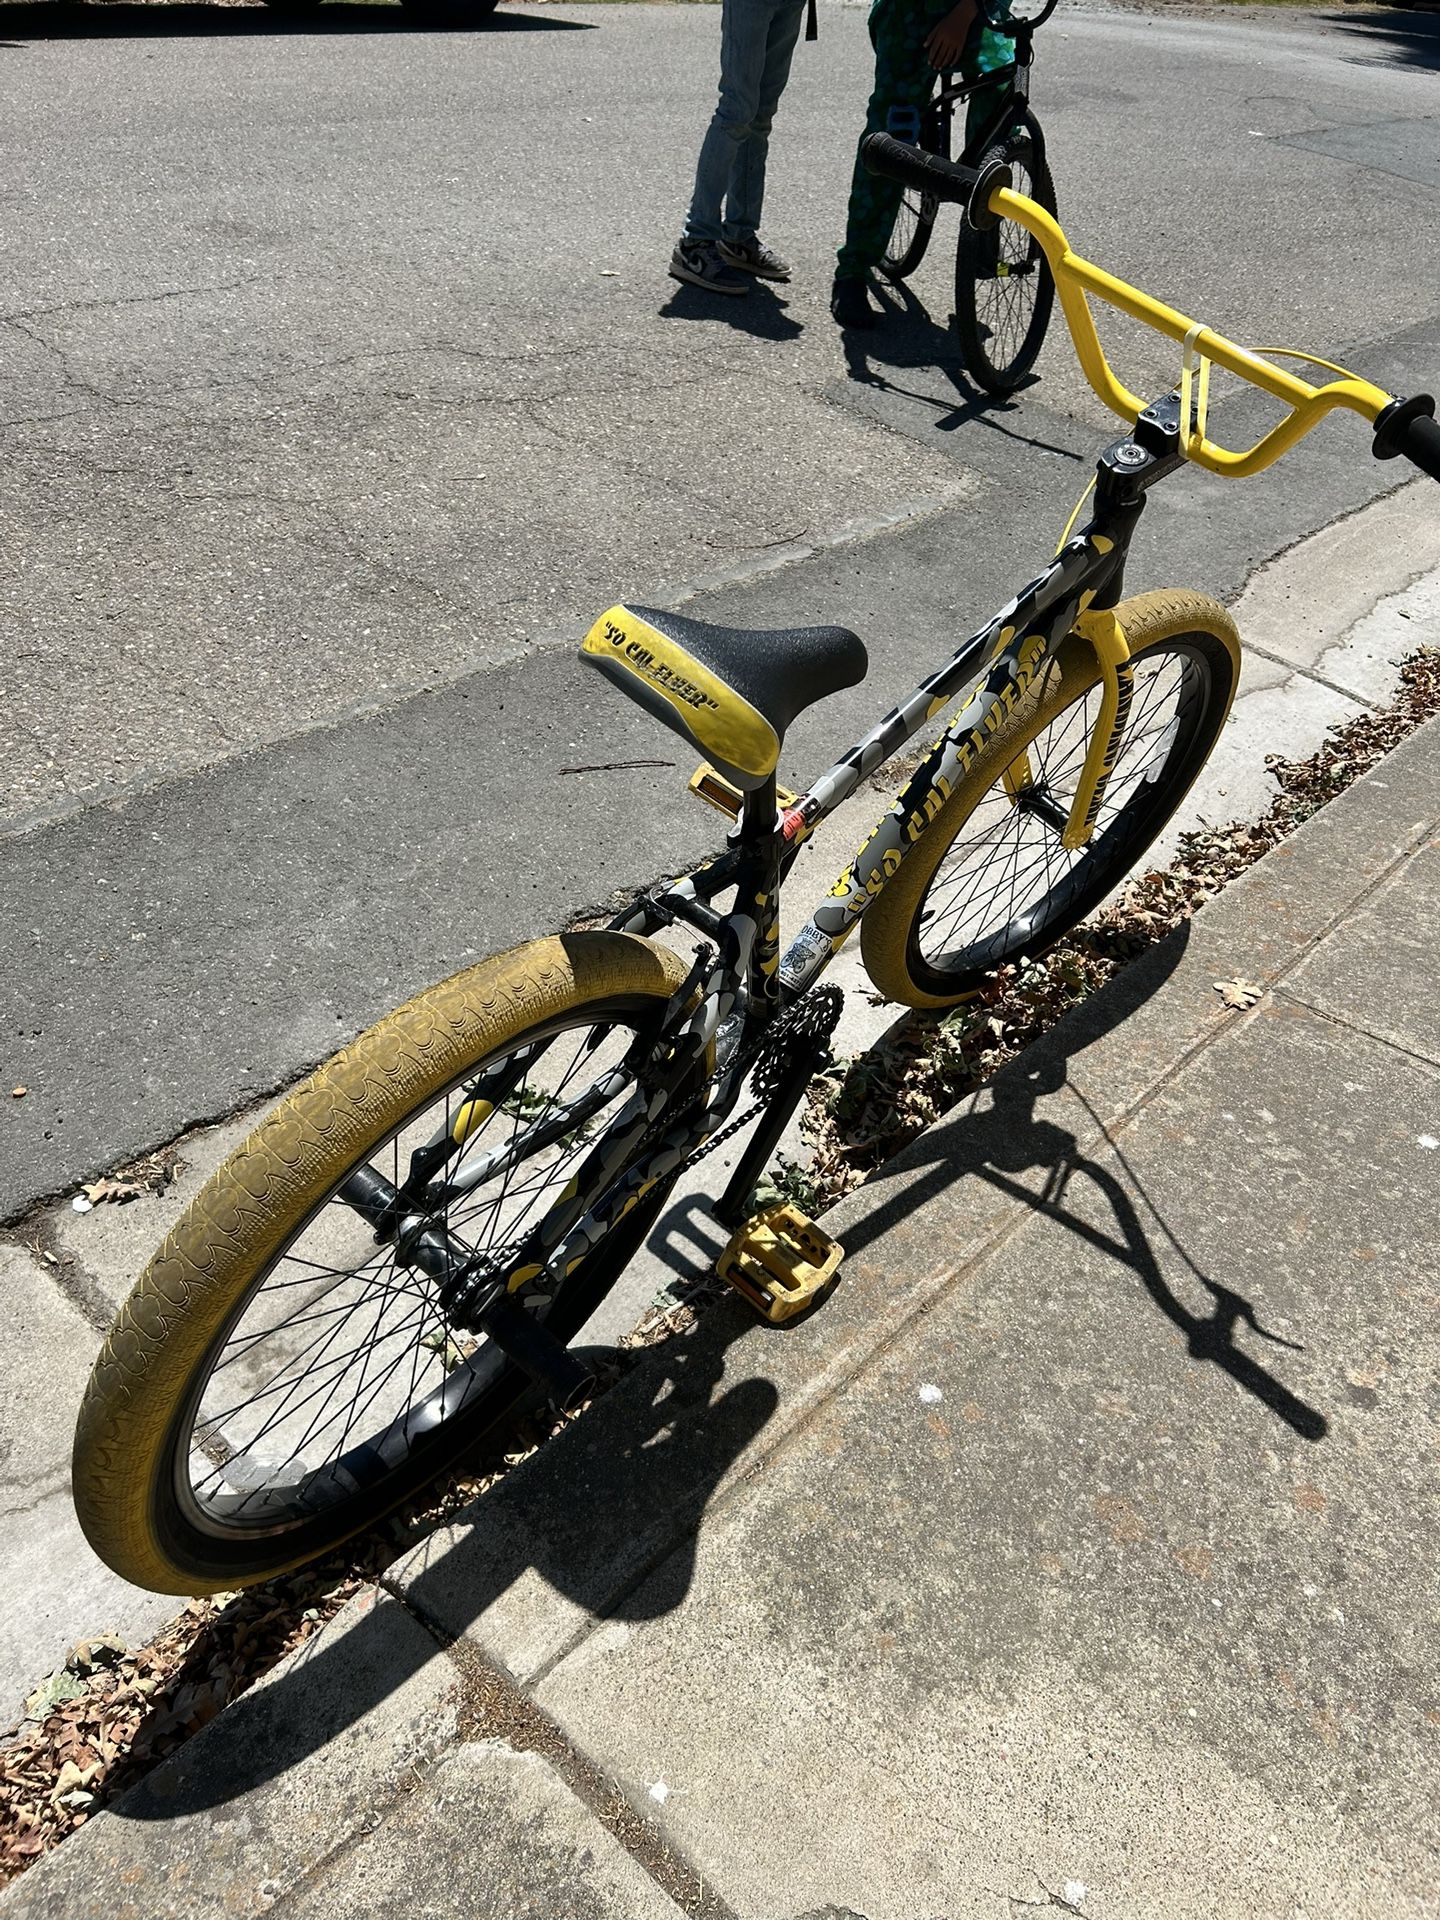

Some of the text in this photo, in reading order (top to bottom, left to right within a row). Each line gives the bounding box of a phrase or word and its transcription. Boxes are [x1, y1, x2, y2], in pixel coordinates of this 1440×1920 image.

[624, 641, 656, 671] CAL
[906, 774, 951, 842] CAL
[800, 925, 832, 953] OBBY'S
